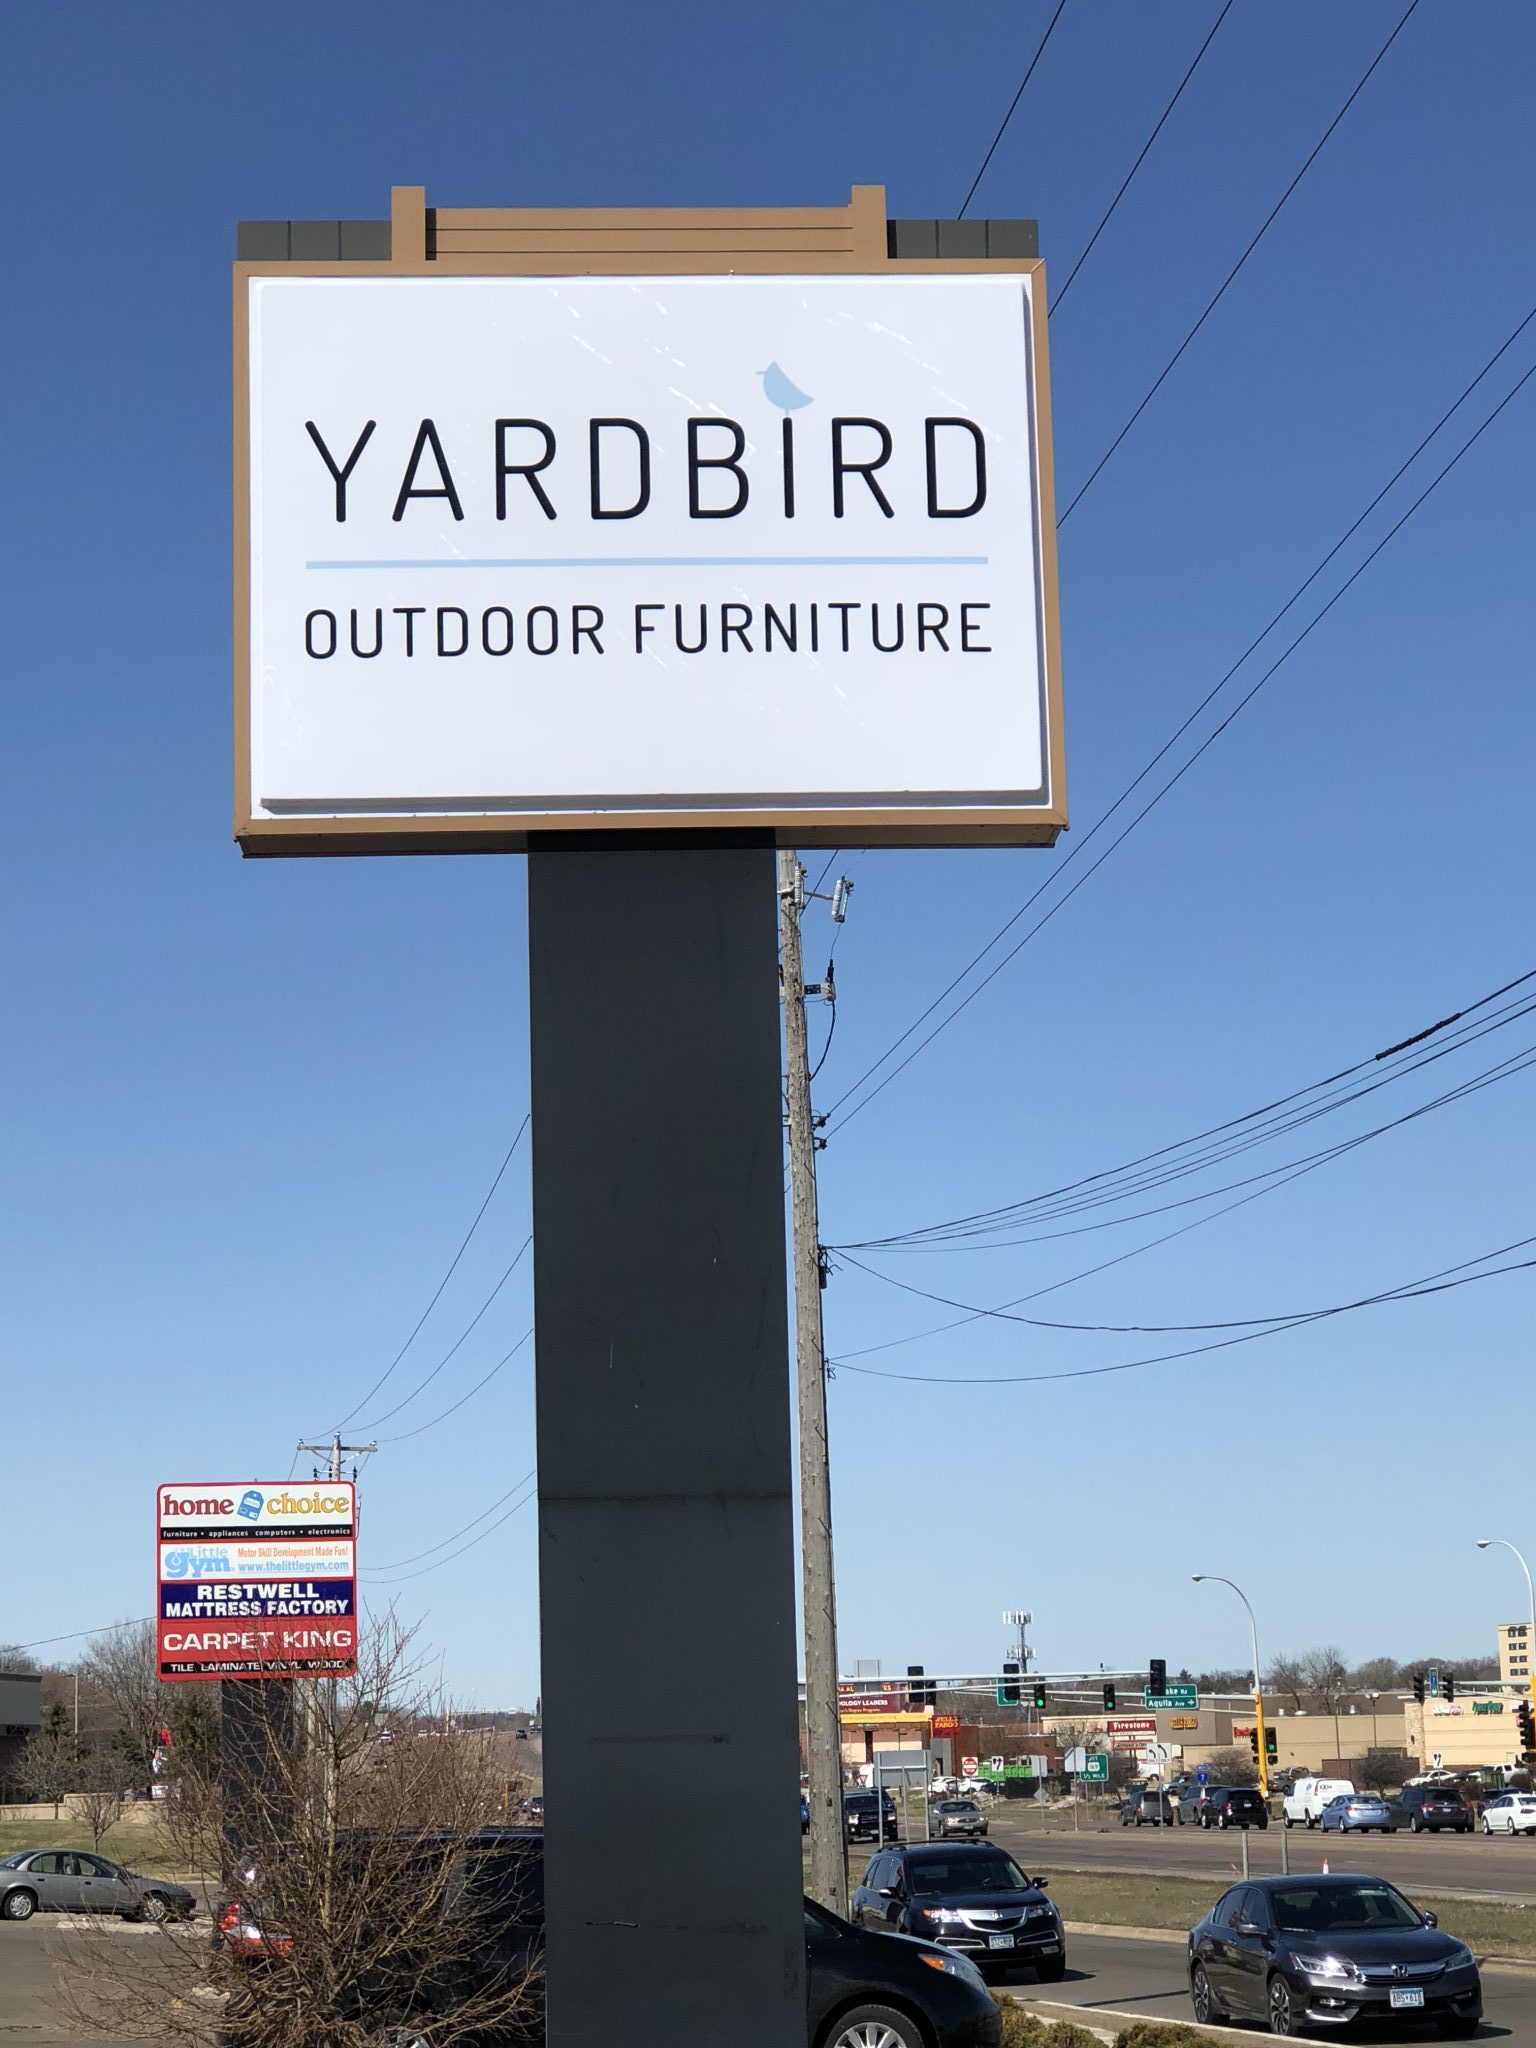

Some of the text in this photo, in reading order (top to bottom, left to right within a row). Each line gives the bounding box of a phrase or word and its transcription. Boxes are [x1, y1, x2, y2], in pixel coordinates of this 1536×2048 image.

[304, 416, 987, 523] YARDBIRD
[304, 602, 992, 660] OUTDOOR FURNITURE
[163, 1494, 234, 1516] home
[266, 1492, 350, 1514] choice
[208, 1529, 249, 1538] appliances
[255, 1529, 295, 1537] computers
[307, 1528, 350, 1536] electronics
[238, 1547, 257, 1558] Motor
[273, 1546, 314, 1559] Development
[315, 1546, 333, 1557] Made
[164, 1551, 231, 1578] gym
[238, 1560, 349, 1572] www.thelittlegym.com
[197, 1583, 319, 1600] RESTWELL
[166, 1599, 349, 1617] MATTRESS FACTORY
[163, 1630, 352, 1651] CARPET KING
[171, 1660, 345, 1672] TILE LAMINATE VINYL WOOD
[1148, 1699, 1173, 1708] Aquila
